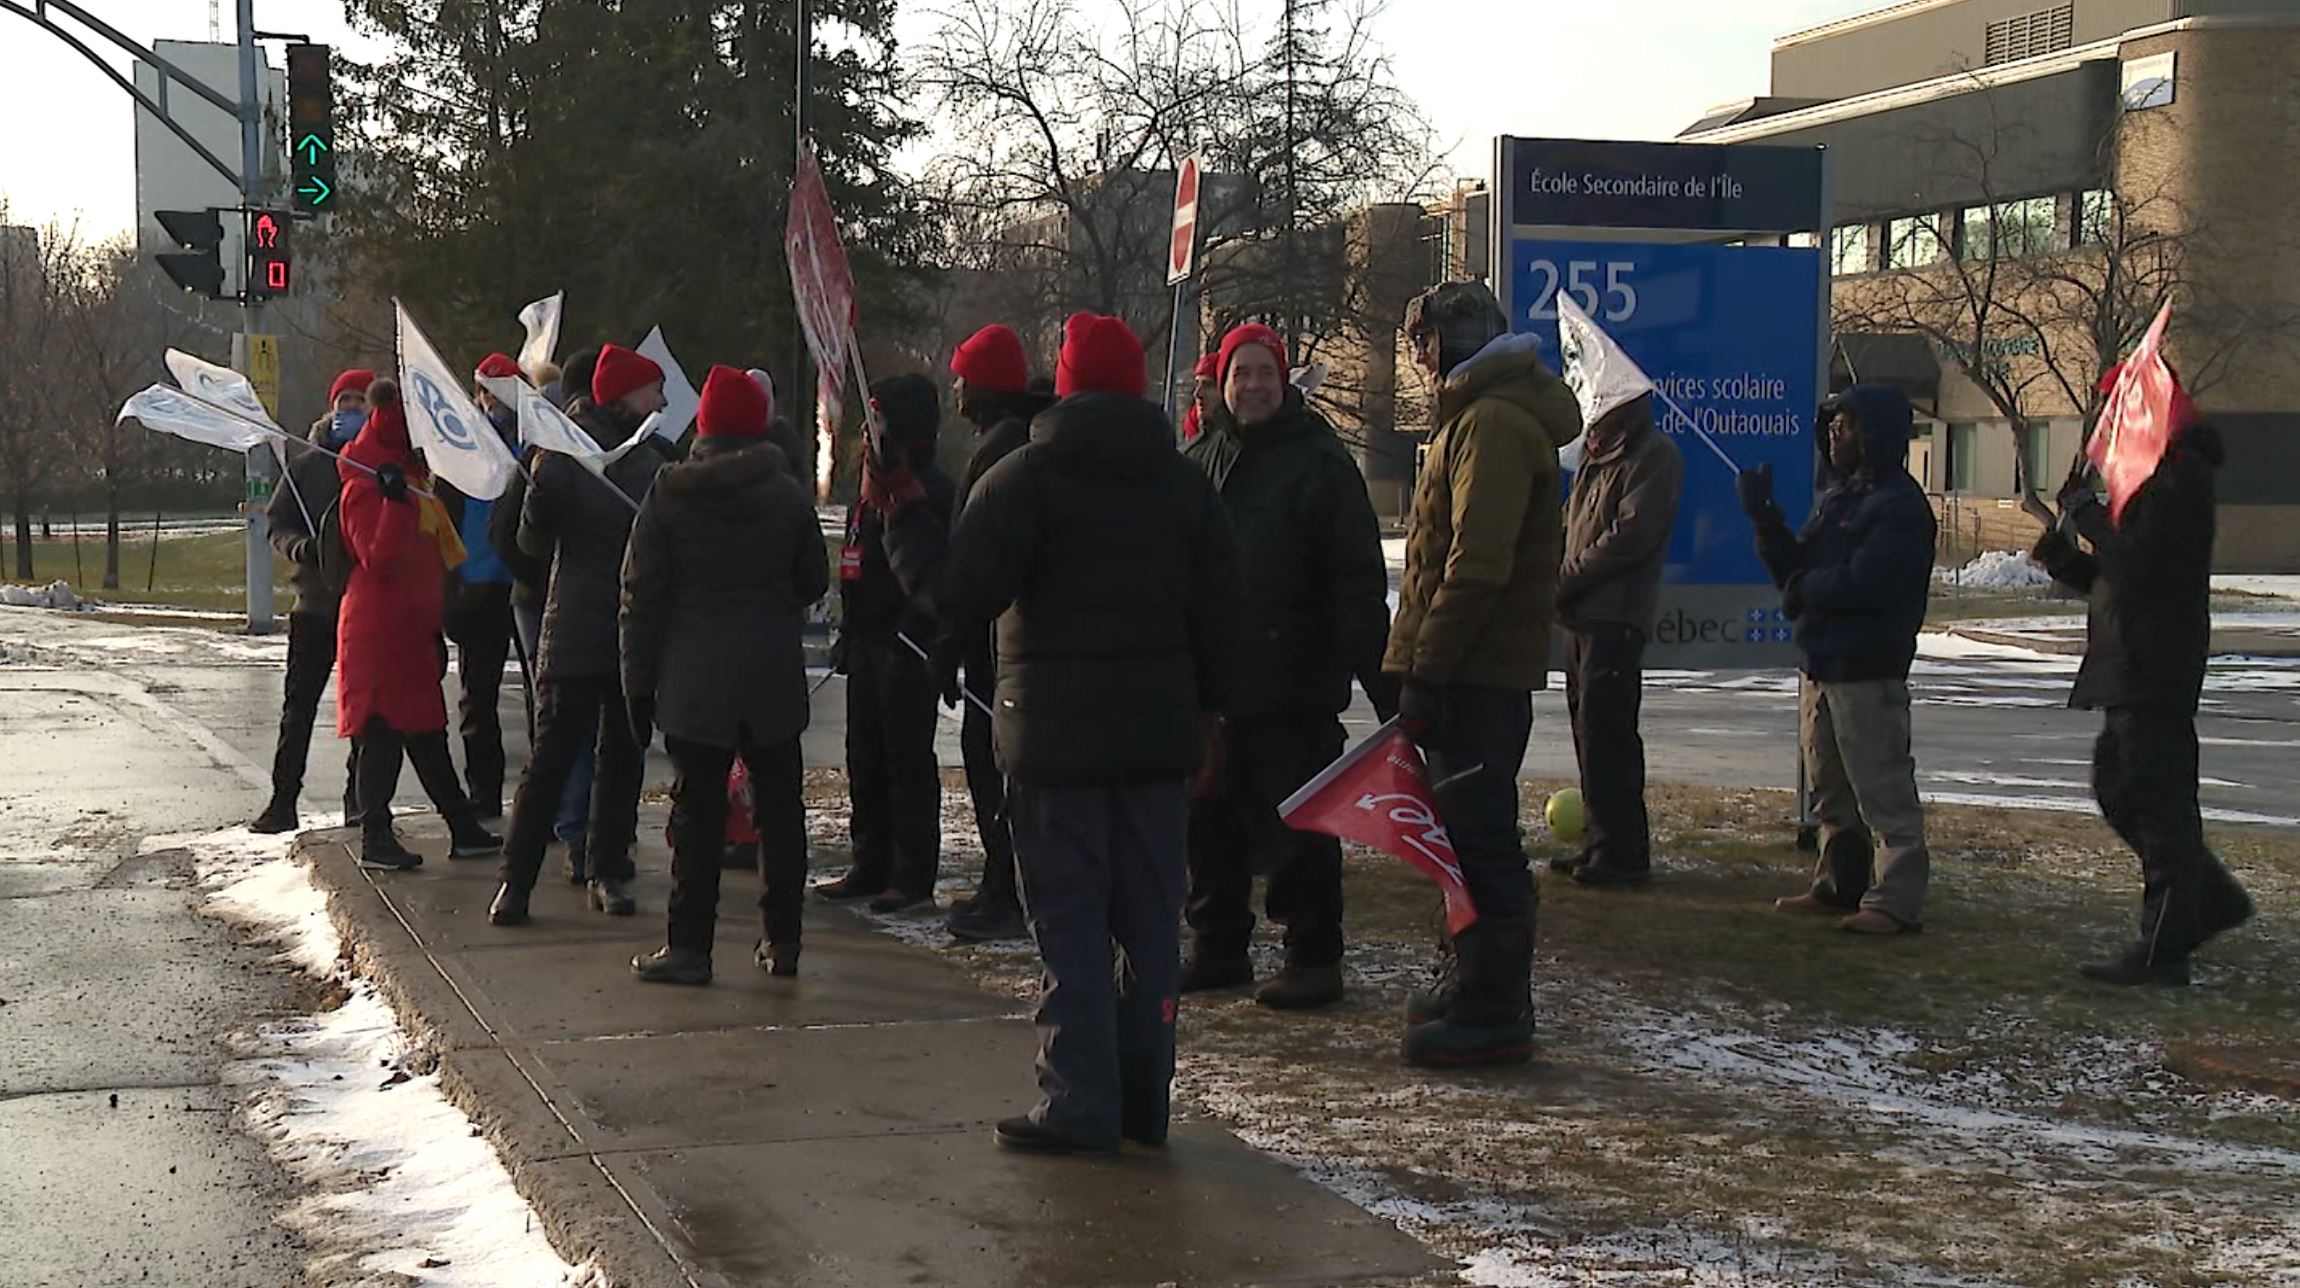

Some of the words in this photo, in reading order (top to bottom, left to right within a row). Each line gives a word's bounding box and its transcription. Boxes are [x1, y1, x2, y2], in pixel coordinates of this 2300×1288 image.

[1531, 167, 1578, 194] École
[1582, 172, 1679, 197] Secondaire
[1683, 176, 1706, 198] de
[1710, 173, 1743, 199] l'Île
[1527, 258, 1637, 322] 255
[1650, 371, 1706, 400] rvices
[1711, 372, 1786, 400] scolaire
[1652, 607, 1740, 644] ébec
